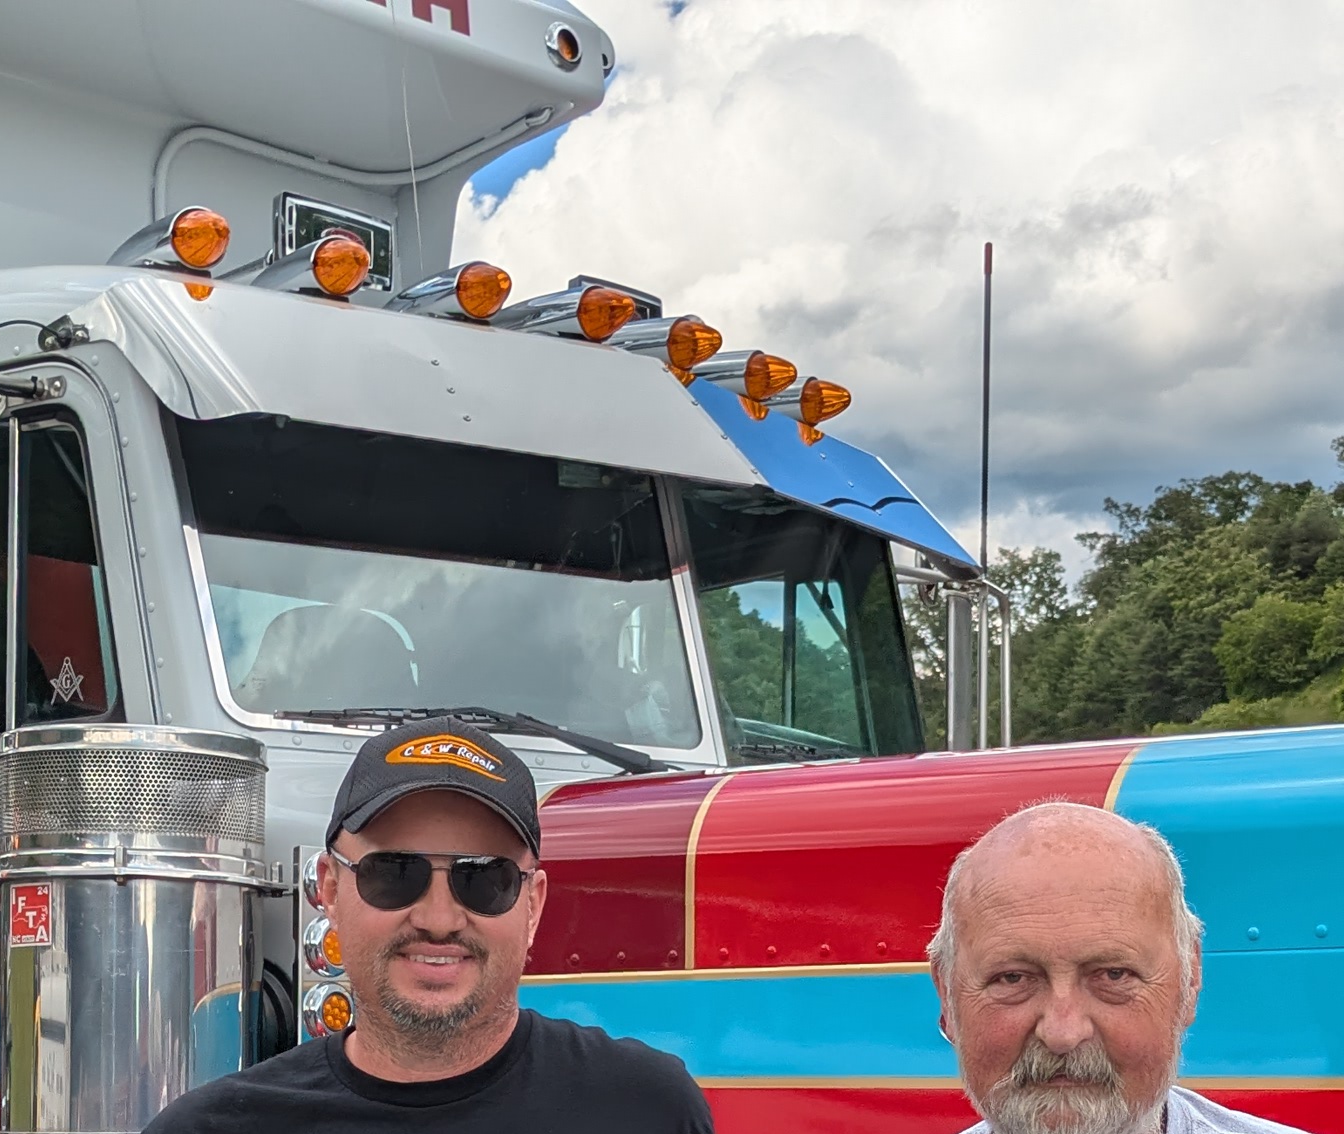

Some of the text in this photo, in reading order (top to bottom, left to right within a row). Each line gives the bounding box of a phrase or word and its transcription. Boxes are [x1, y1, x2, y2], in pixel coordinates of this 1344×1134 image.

[403, 742, 496, 772] C & W Repair
